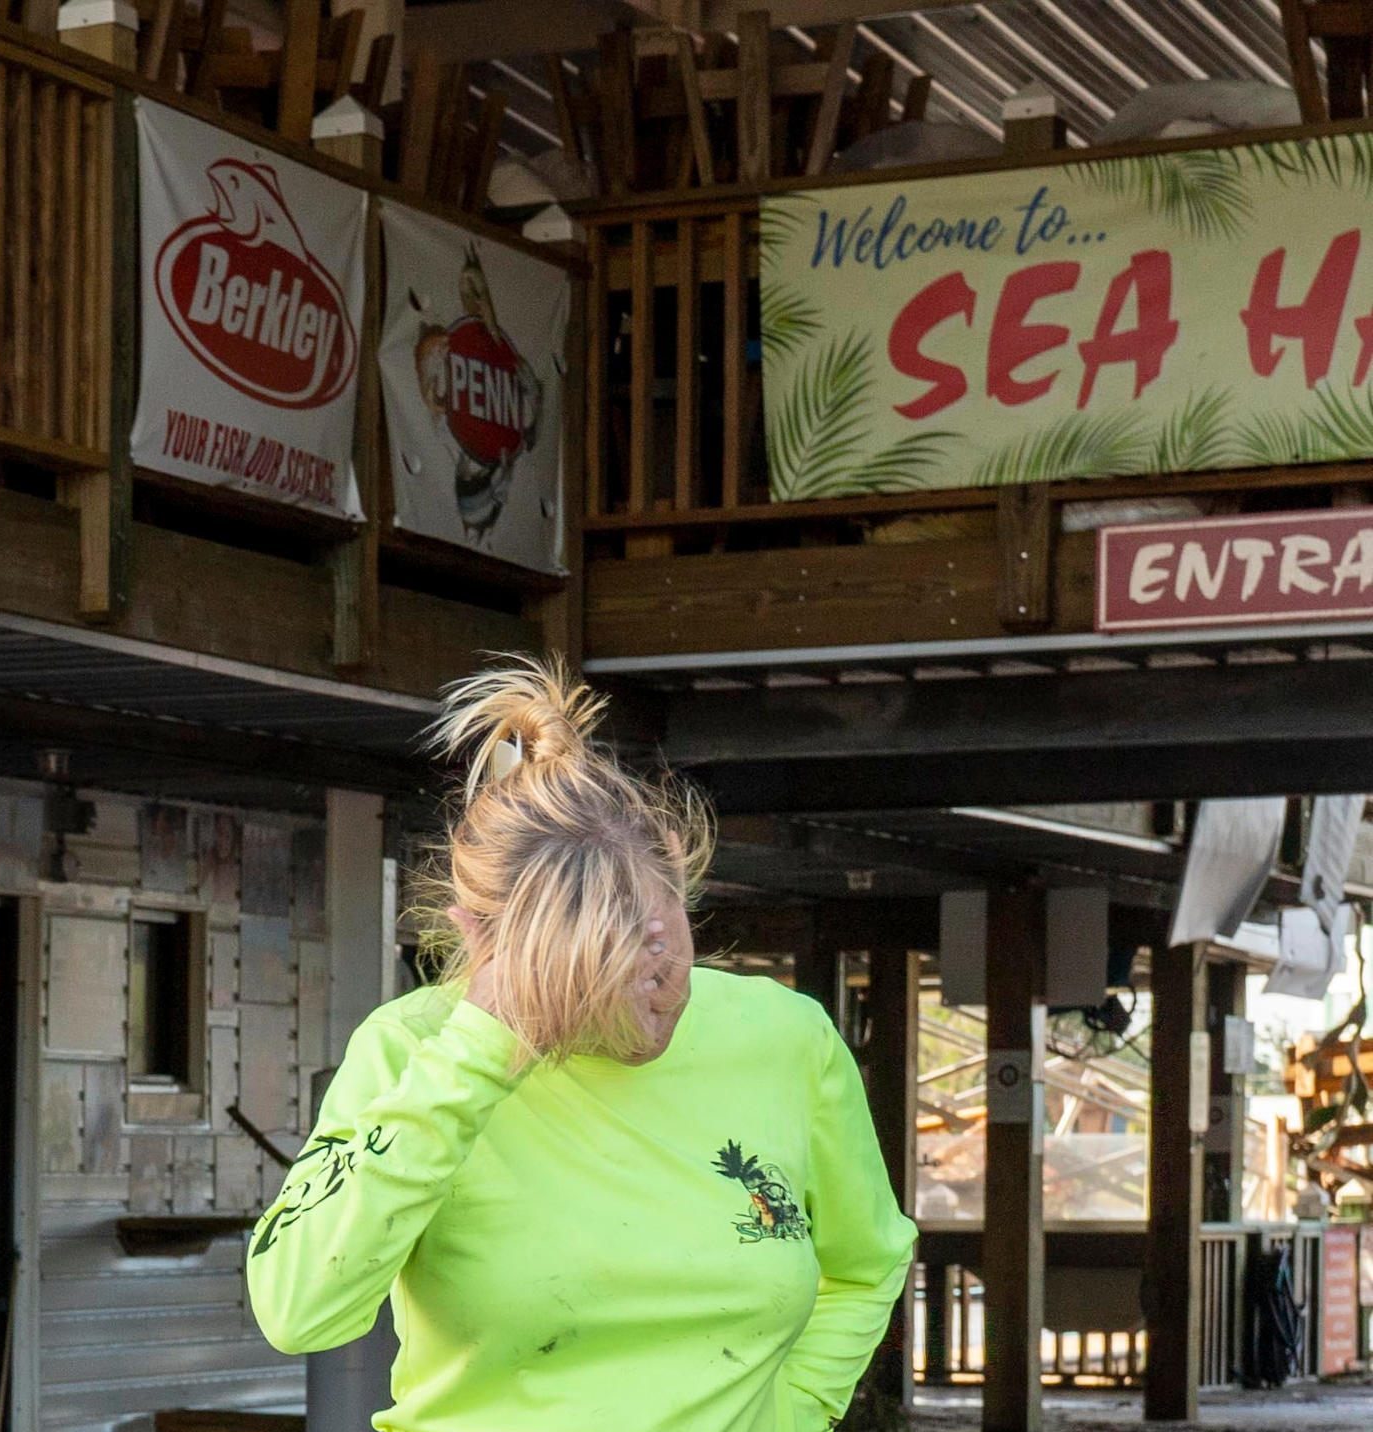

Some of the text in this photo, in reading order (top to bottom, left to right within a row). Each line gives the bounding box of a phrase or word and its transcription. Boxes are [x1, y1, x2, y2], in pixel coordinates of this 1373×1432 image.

[810, 196, 1005, 269] Welcome
[188, 242, 338, 390] Berkley
[887, 228, 1373, 420] SEA H
[450, 352, 520, 431] PENN
[163, 409, 210, 466] YOUR
[244, 436, 284, 484] OUR
